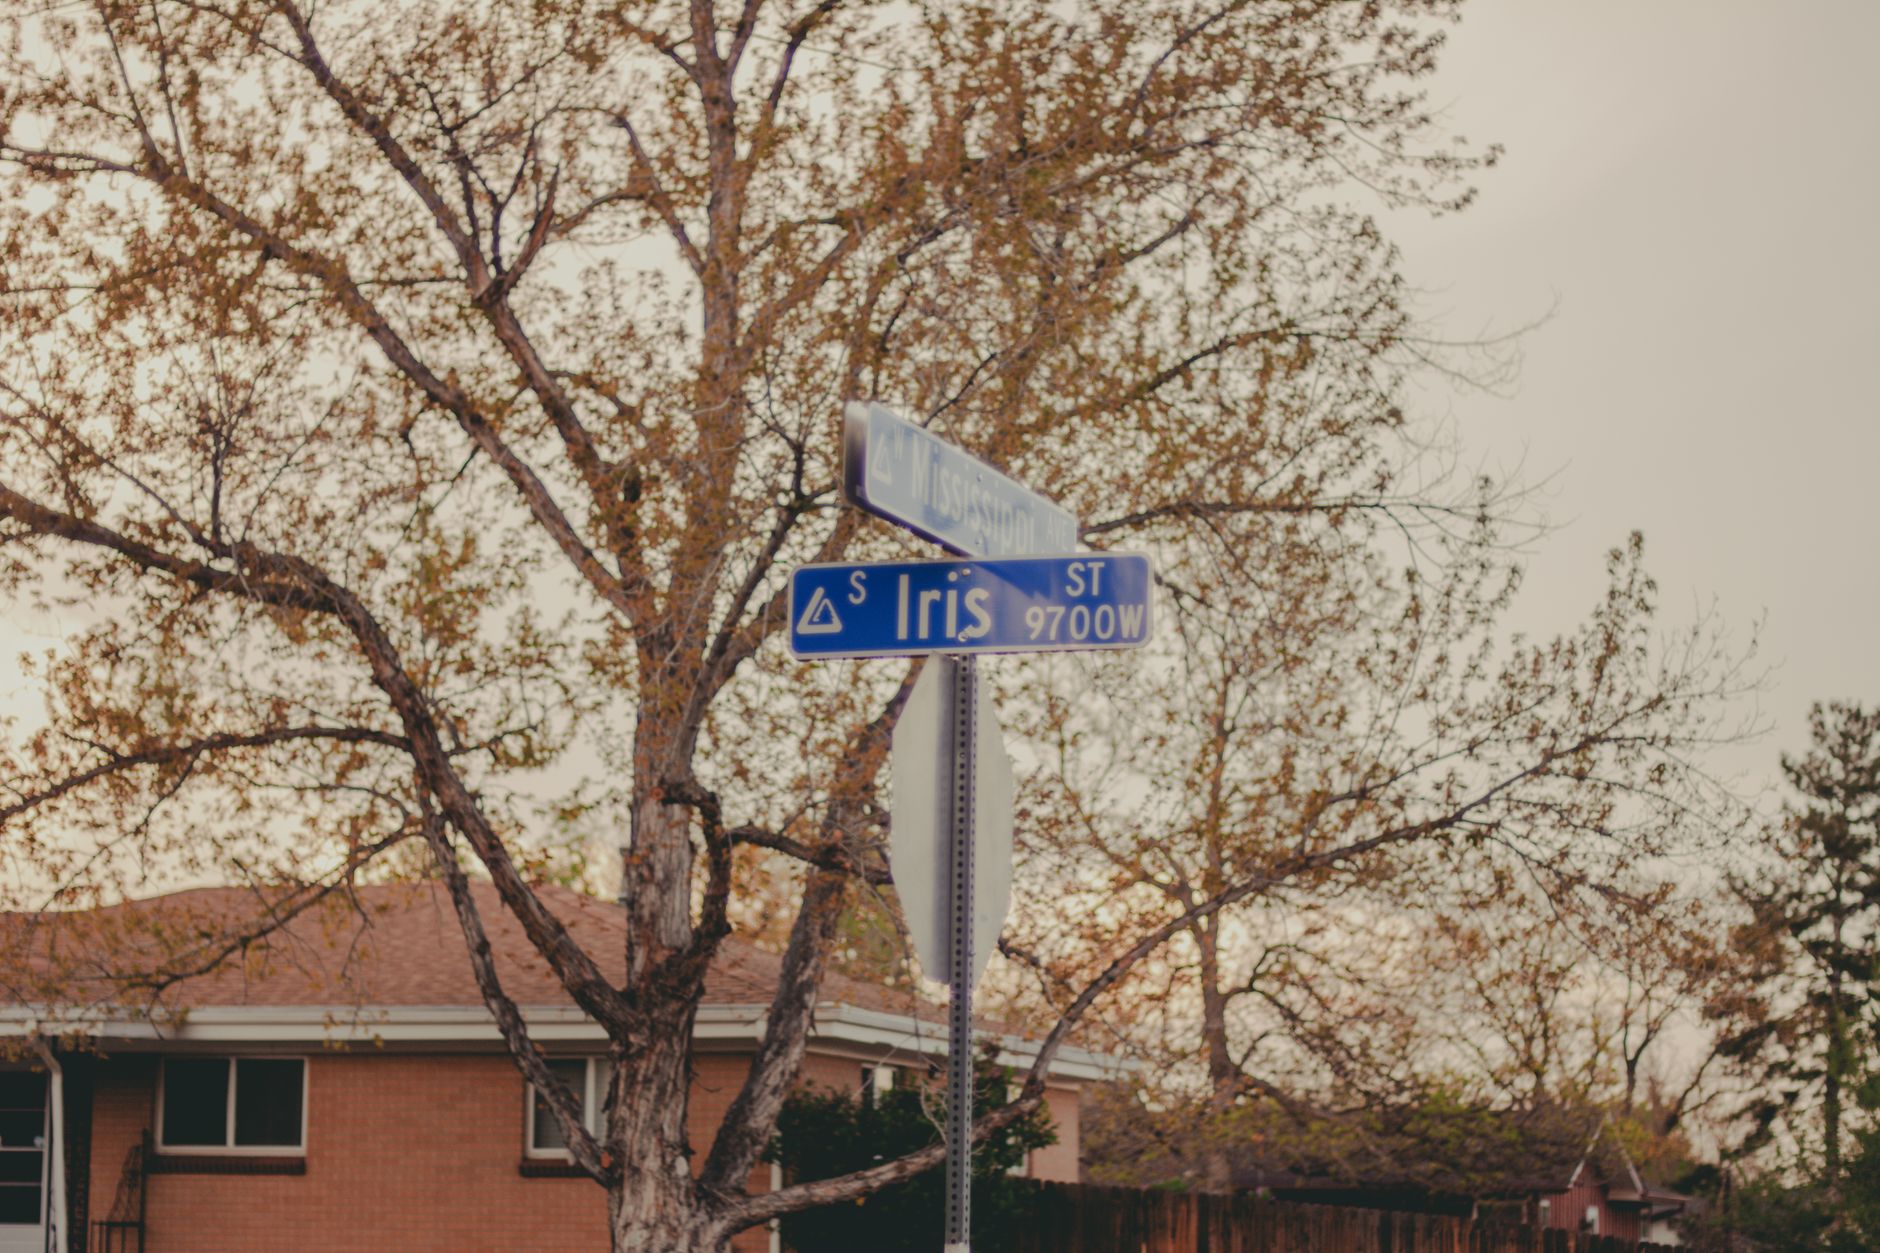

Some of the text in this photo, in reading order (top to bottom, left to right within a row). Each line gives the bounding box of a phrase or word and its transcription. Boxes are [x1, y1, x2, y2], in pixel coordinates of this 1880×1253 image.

[911, 431, 1034, 554] Mississippi
[848, 561, 1105, 640] S Iris ST
[1025, 604, 1144, 641] 9700W
